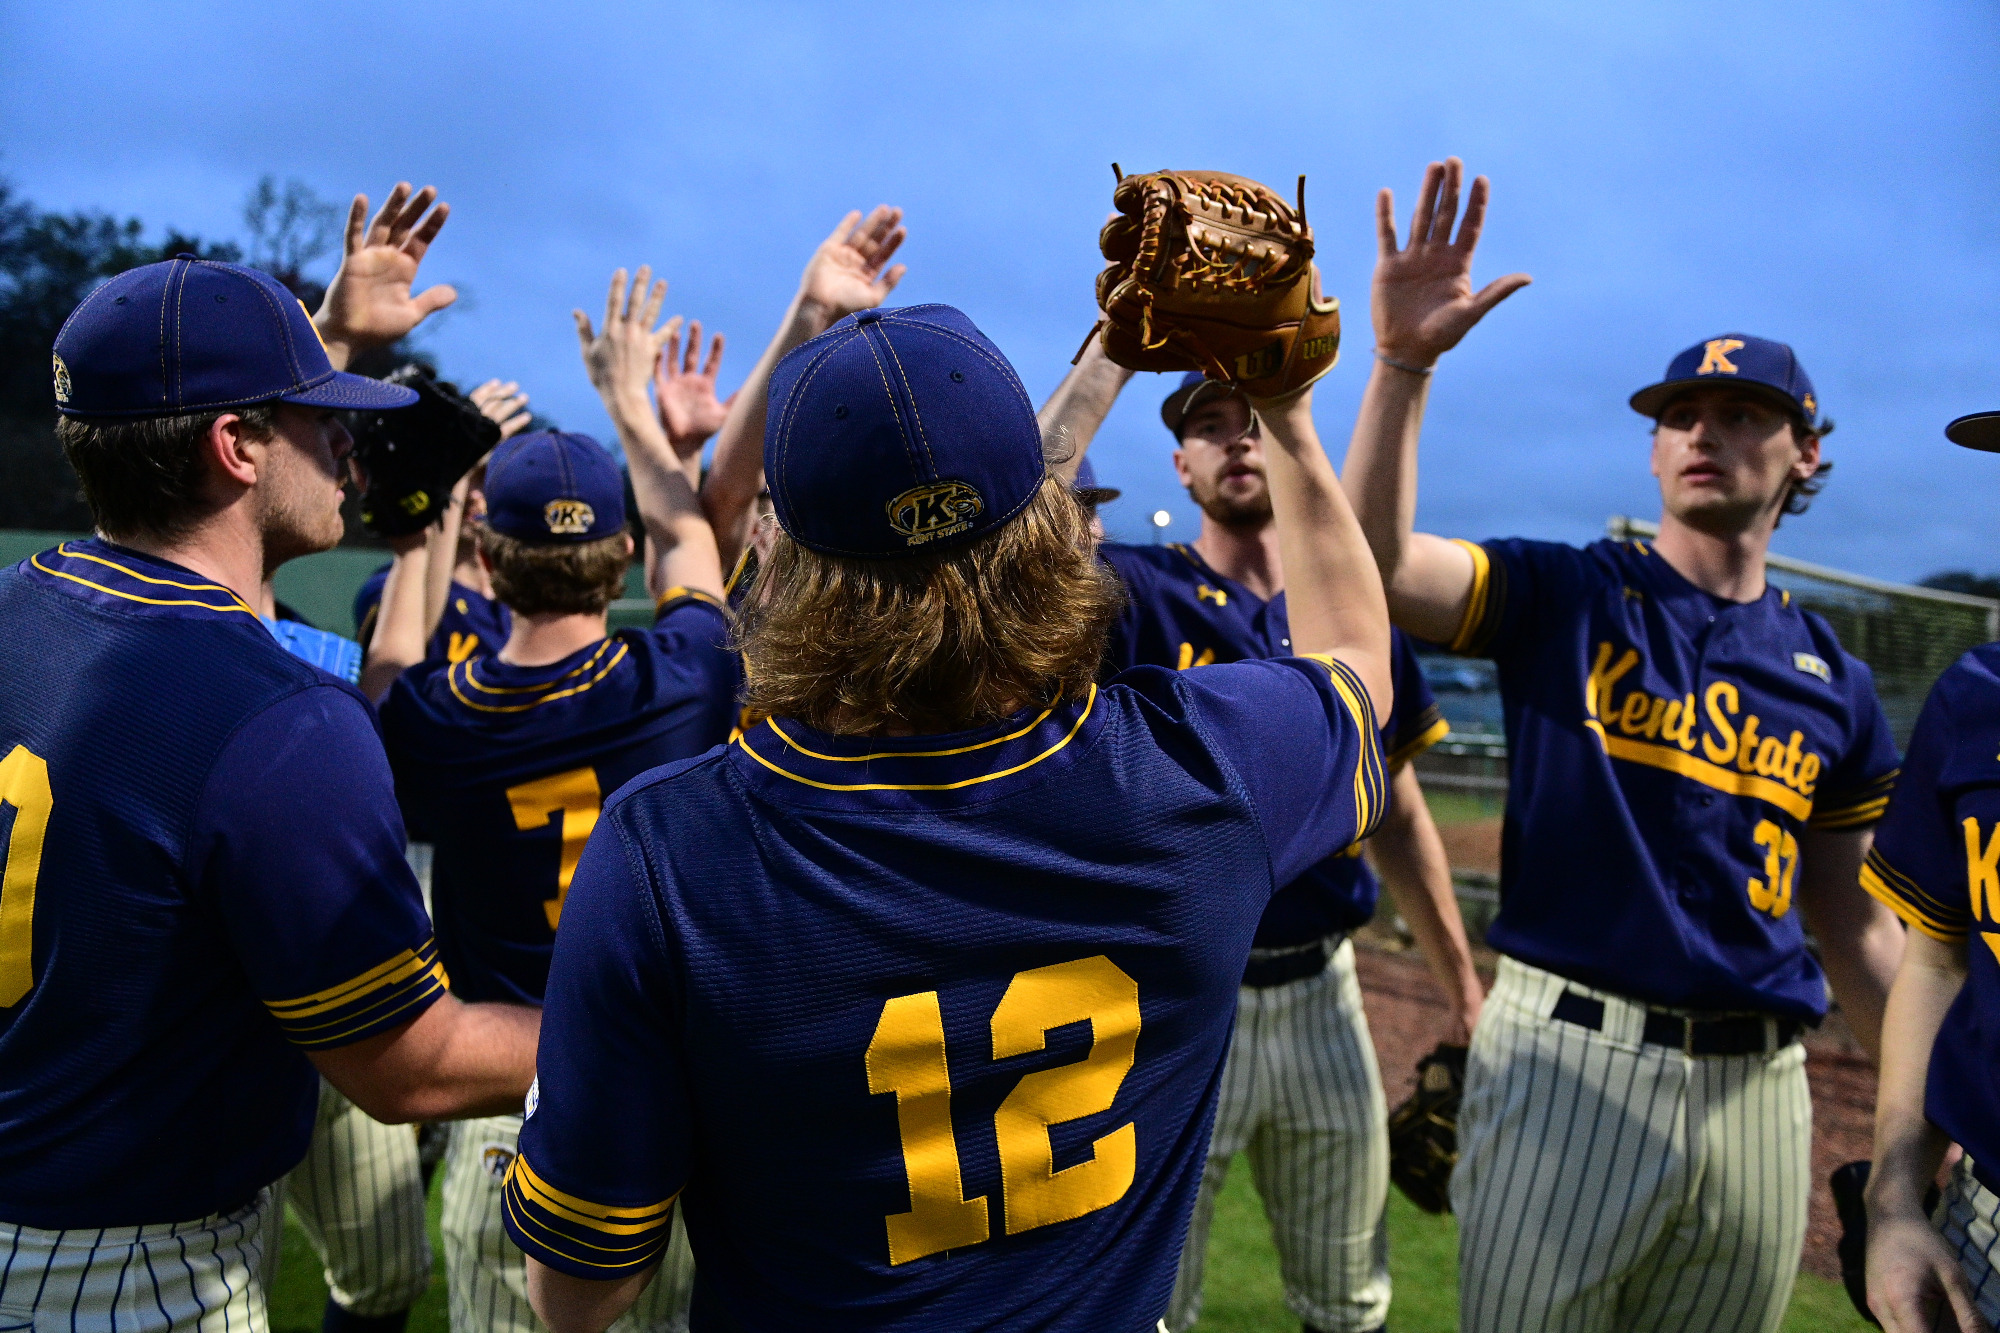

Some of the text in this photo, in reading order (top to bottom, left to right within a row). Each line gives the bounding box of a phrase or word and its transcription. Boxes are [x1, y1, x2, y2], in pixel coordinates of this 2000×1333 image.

[1696, 338, 1746, 376] K
[907, 521, 968, 547] KENT STATE
[1585, 641, 1822, 797] Kent State
[506, 766, 602, 931] 7
[864, 954, 1142, 1267] 12
